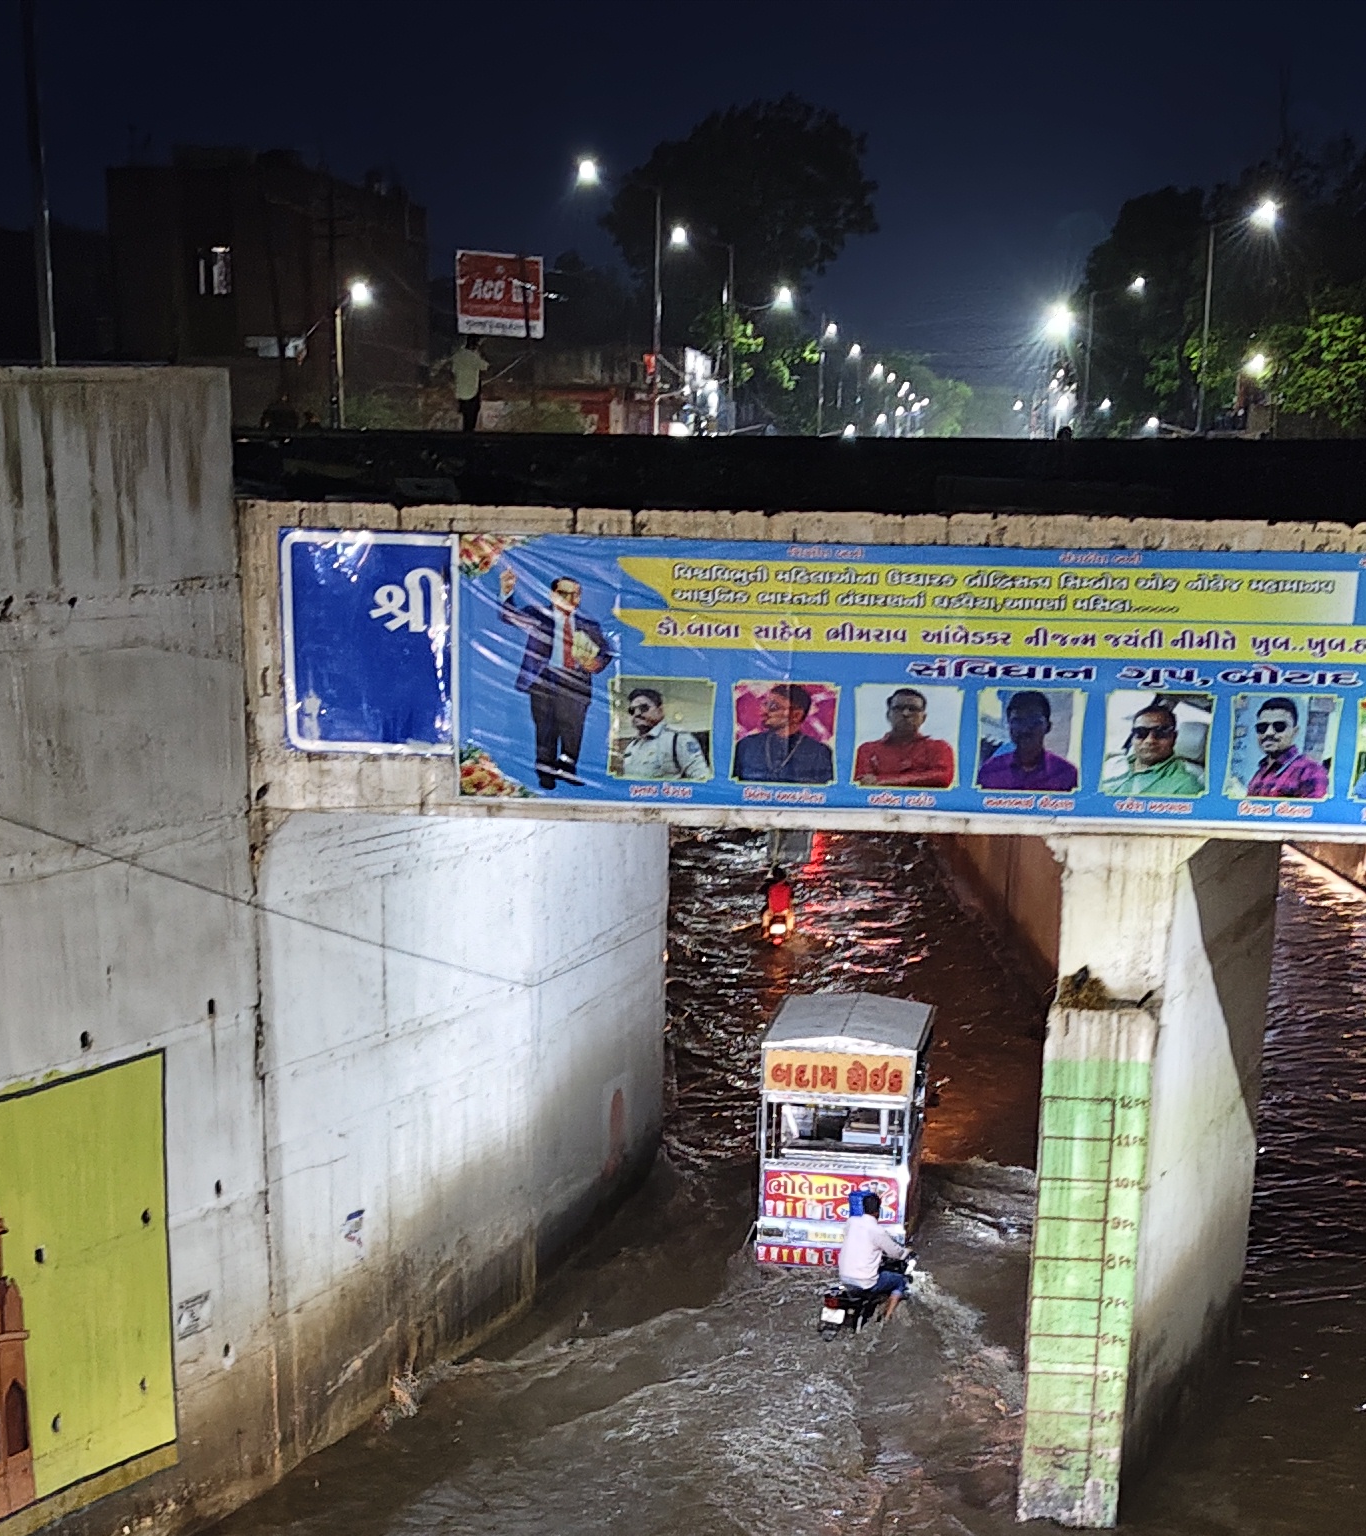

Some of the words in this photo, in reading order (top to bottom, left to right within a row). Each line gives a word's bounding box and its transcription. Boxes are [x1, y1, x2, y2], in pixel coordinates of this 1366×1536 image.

[369, 567, 447, 634] શ્રી
[672, 586, 751, 607] આધુનિક
[753, 619, 813, 642] સાહેબ
[825, 621, 909, 643] ભીમરાવ
[921, 624, 1012, 646] આંબેડકર
[1103, 628, 1163, 649] જયંતી
[905, 657, 1097, 682] સંવિધાન
[771, 1061, 838, 1091] બદામ
[766, 1171, 857, 1199] ભોલેનાથ
